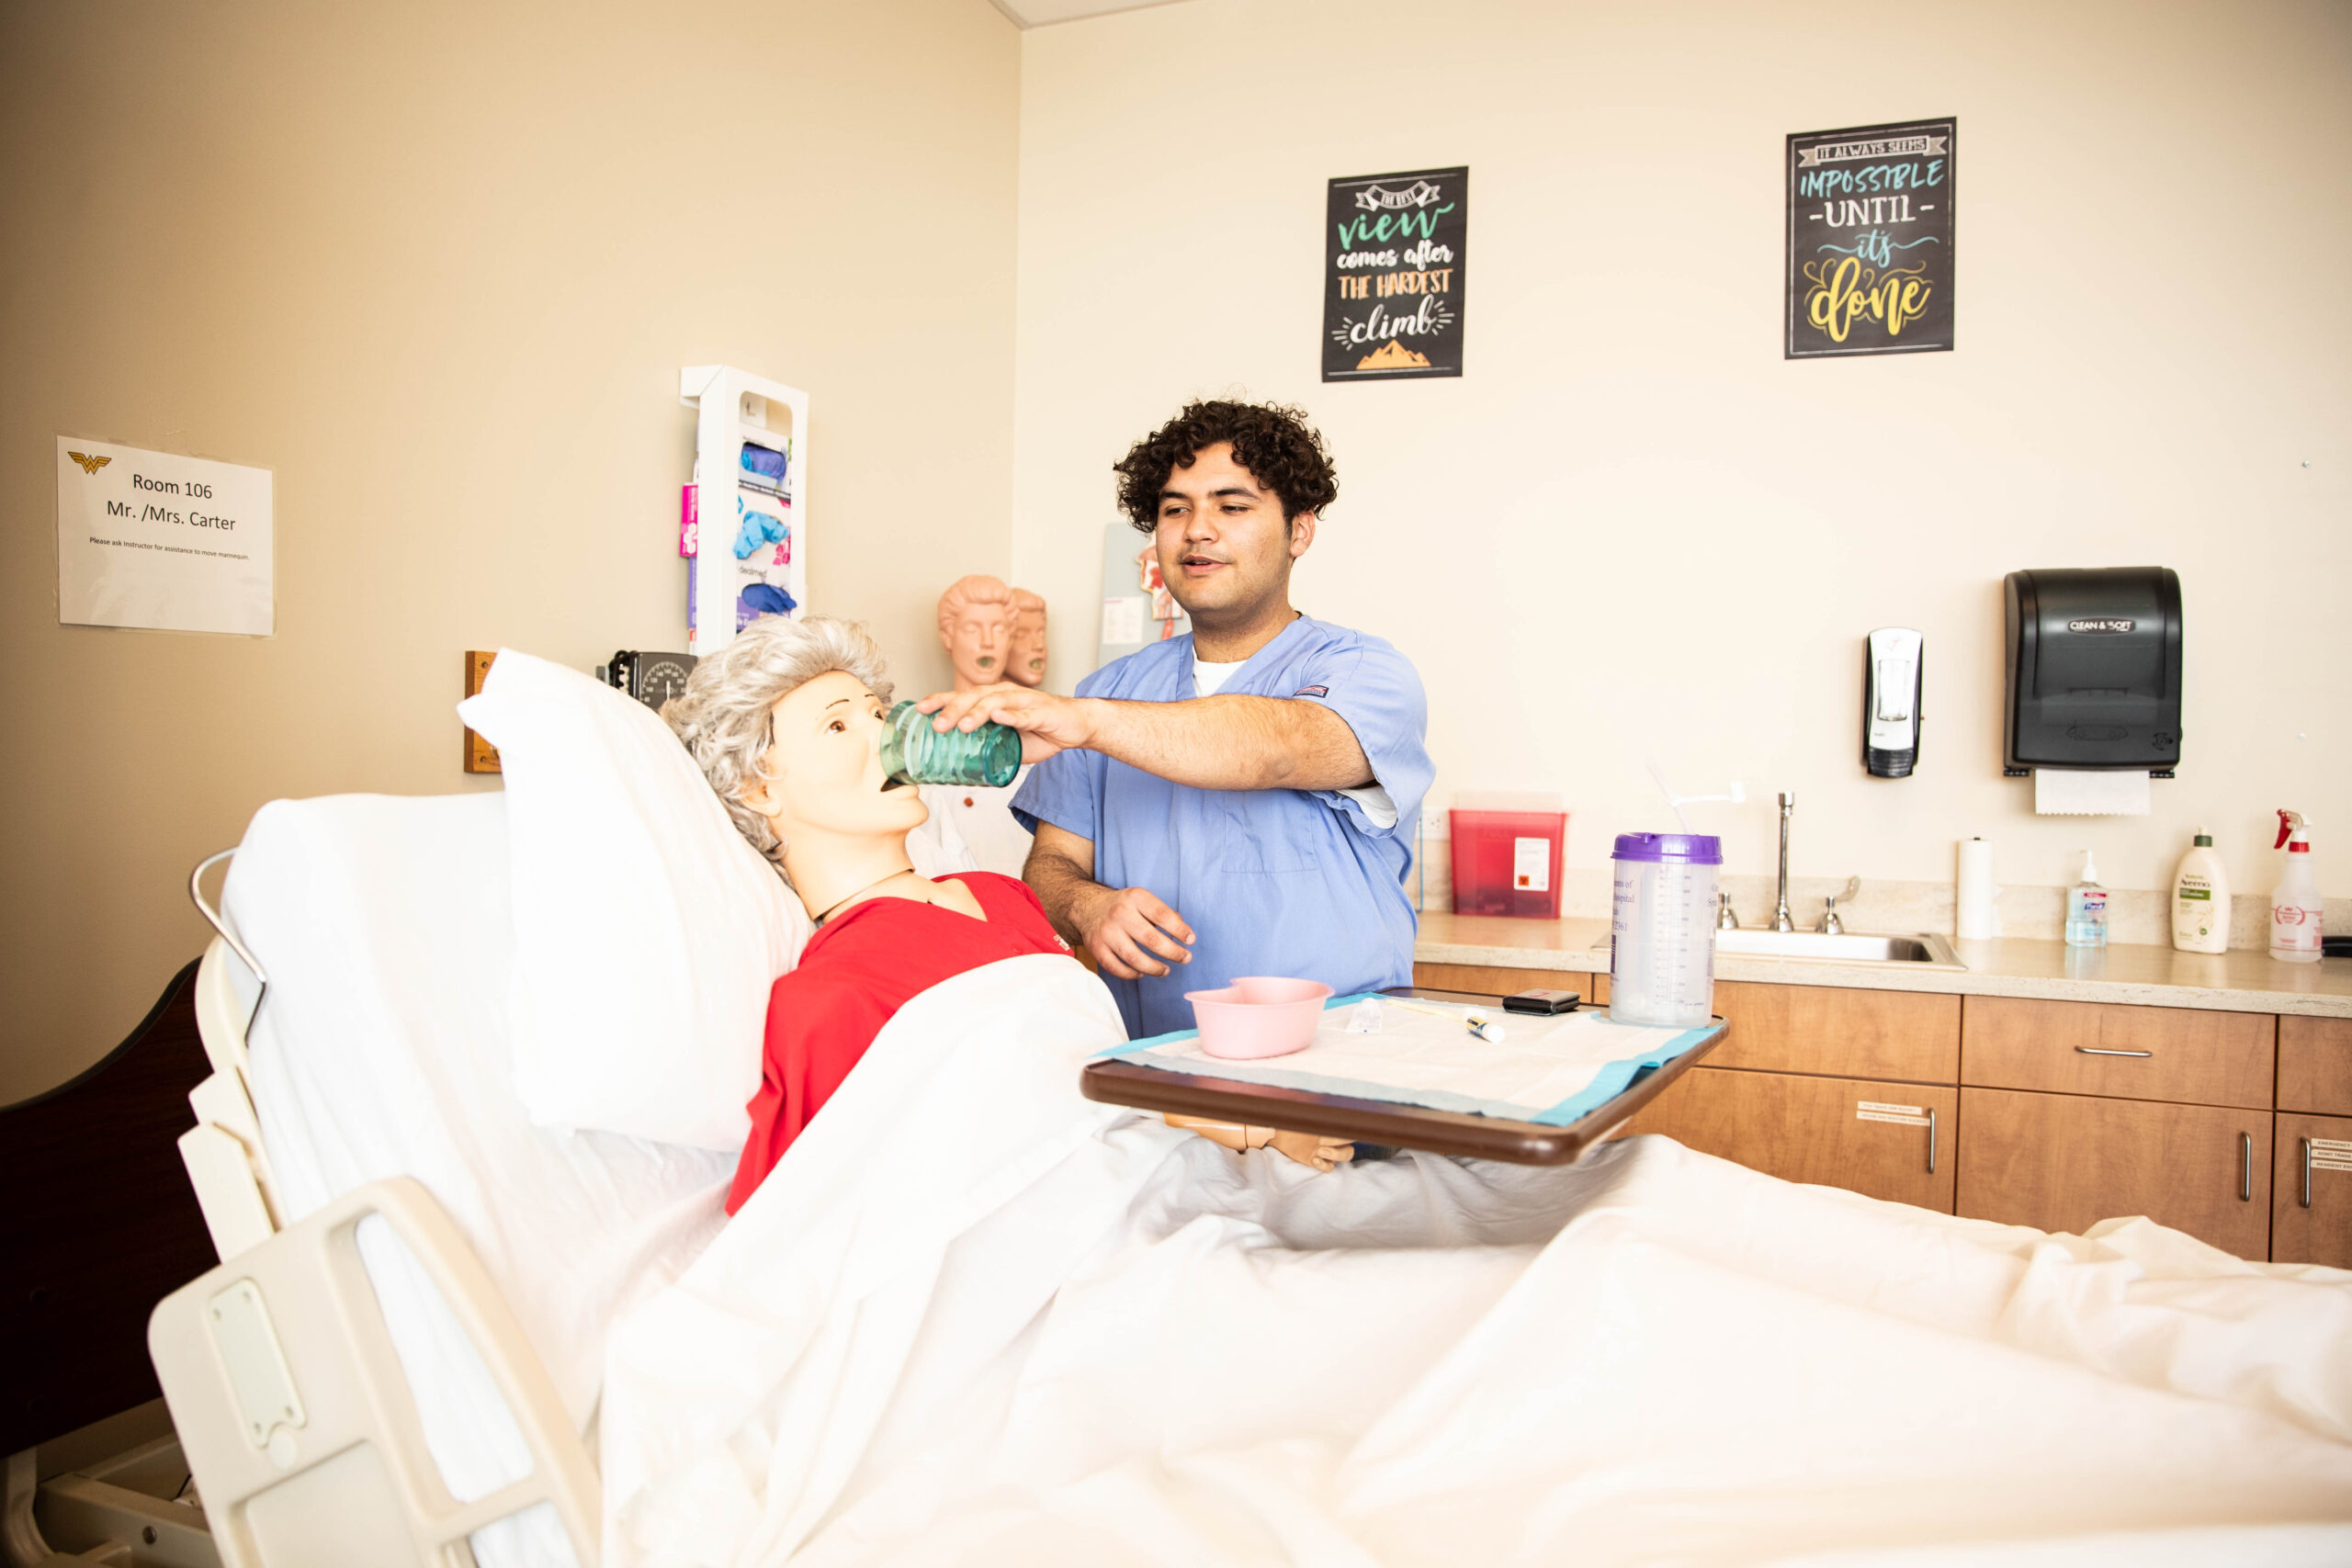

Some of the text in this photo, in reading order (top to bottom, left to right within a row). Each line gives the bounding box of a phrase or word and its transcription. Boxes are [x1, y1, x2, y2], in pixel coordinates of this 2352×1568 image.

[1835, 142, 1885, 157] ALWAYS
[1888, 139, 1926, 152] SEEMS
[1799, 159, 1944, 198] IMPOSSIBLE
[1338, 201, 1455, 251] view
[1337, 239, 1454, 271] comes after
[1338, 268, 1454, 300] THE HARDEST
[1811, 256, 1931, 343] done
[1350, 294, 1438, 344] climb
[132, 474, 212, 499] Room 106
[107, 501, 236, 530] Mr. /Mrs. Carter
[89, 536, 111, 545] Please
[123, 540, 153, 549] Instructor
[164, 546, 193, 555] assistance
[2069, 620, 2132, 631] CLEAN & SOFT
